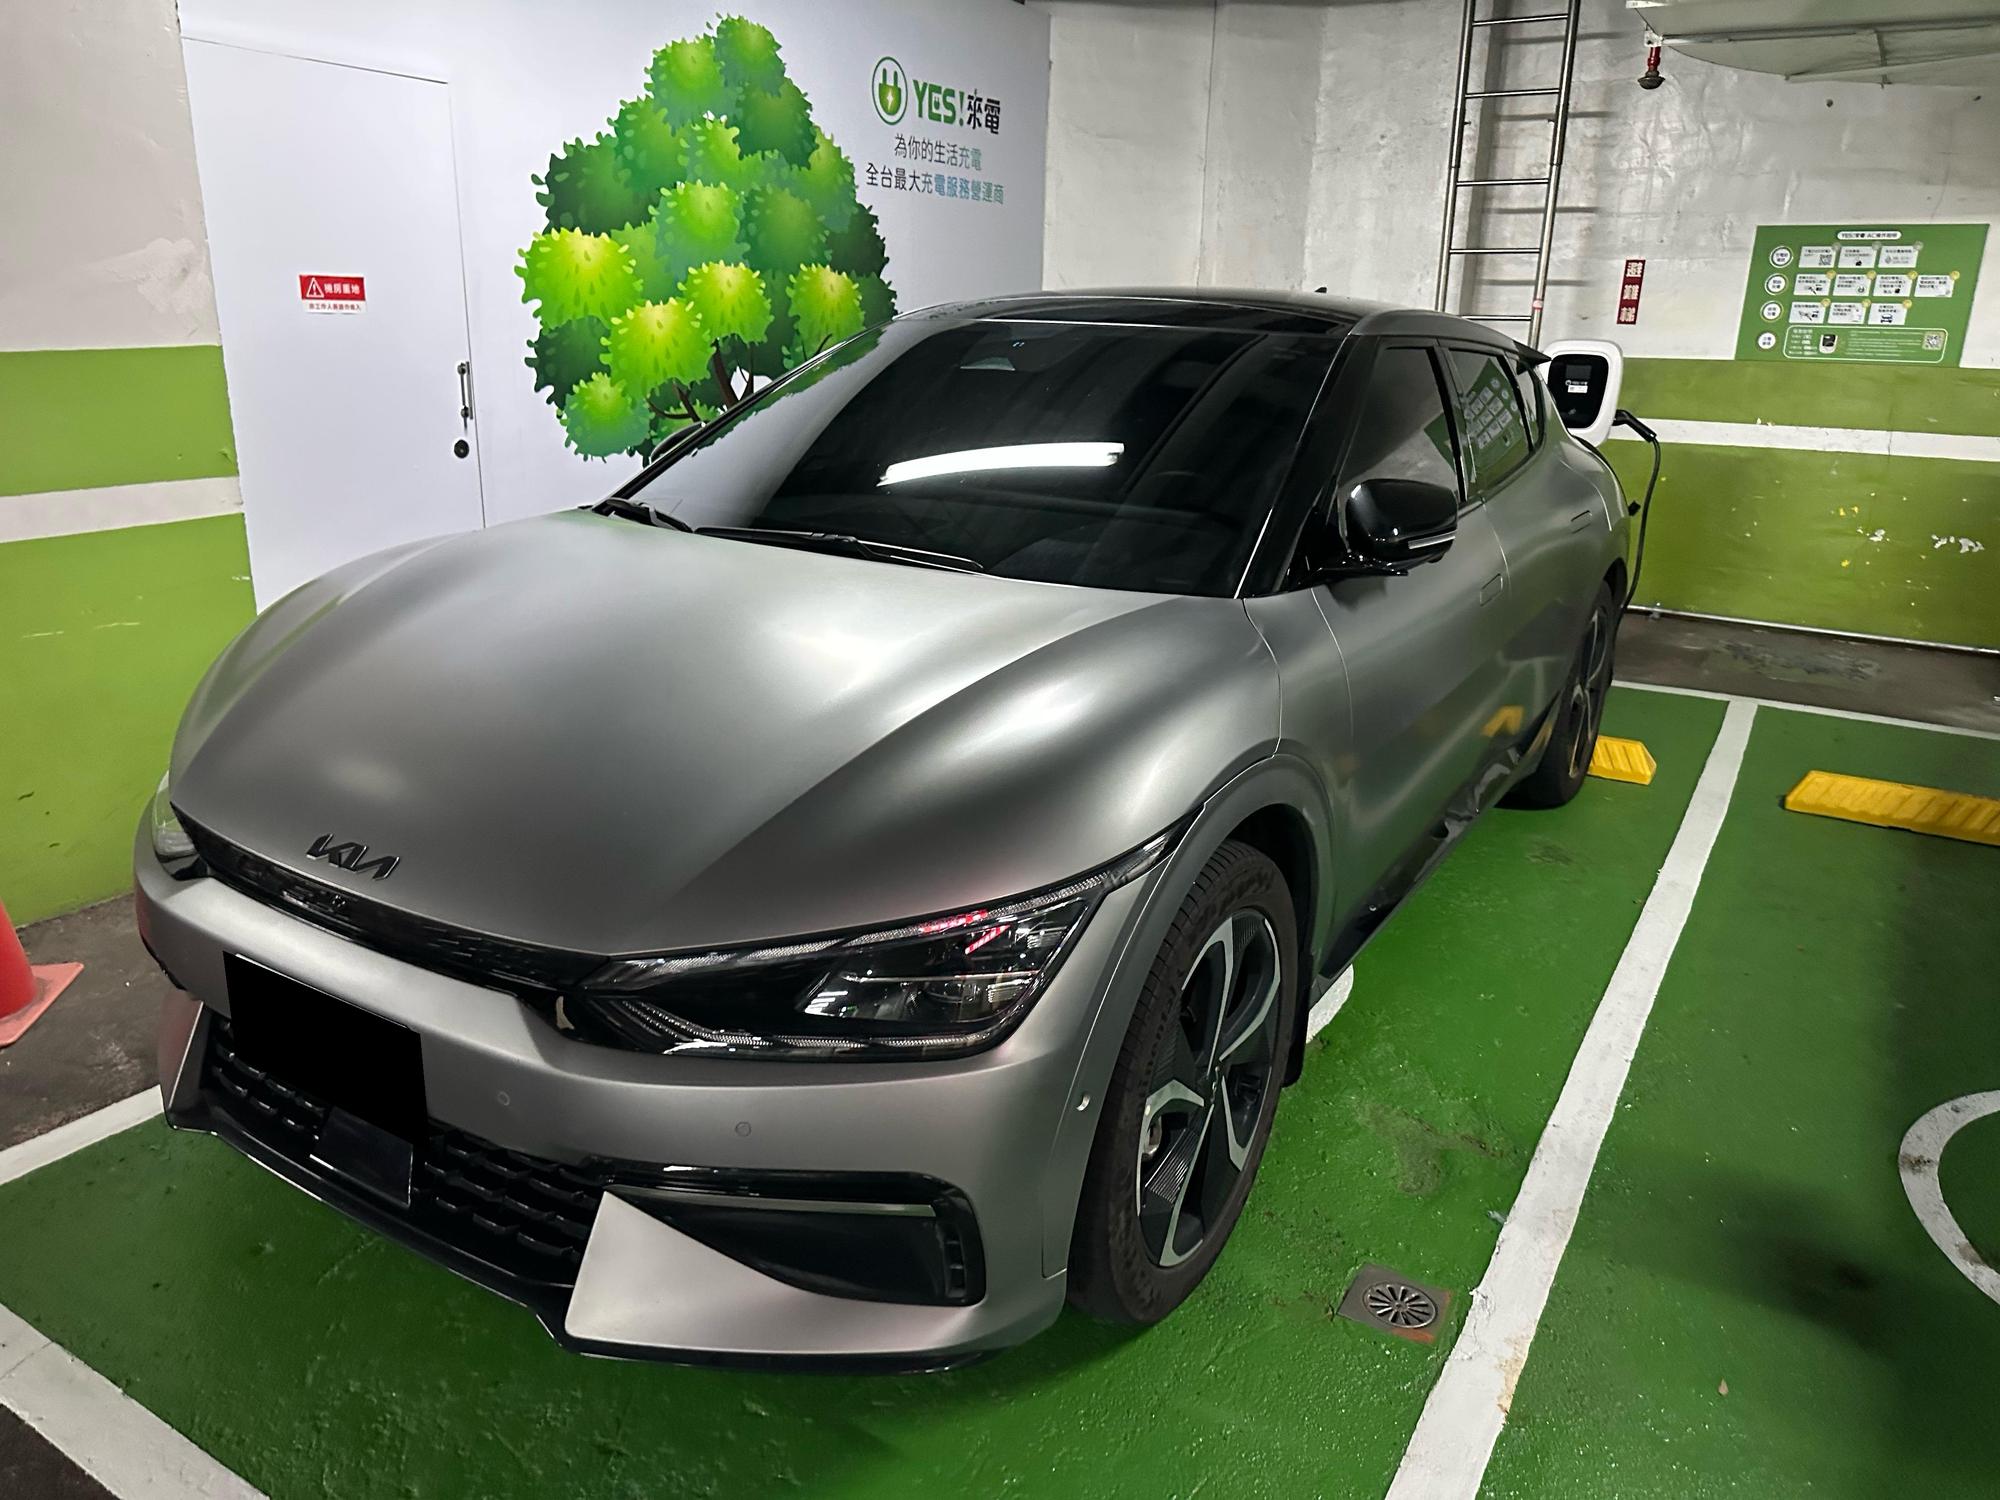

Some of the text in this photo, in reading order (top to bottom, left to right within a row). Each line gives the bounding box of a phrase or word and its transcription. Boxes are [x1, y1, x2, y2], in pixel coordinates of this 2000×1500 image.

[912, 79, 1001, 134] YES!來電
[894, 133, 982, 171] 為你的生活充電
[865, 163, 1004, 205] 全台最大充電服務營運商
[306, 833, 400, 881] KIA
